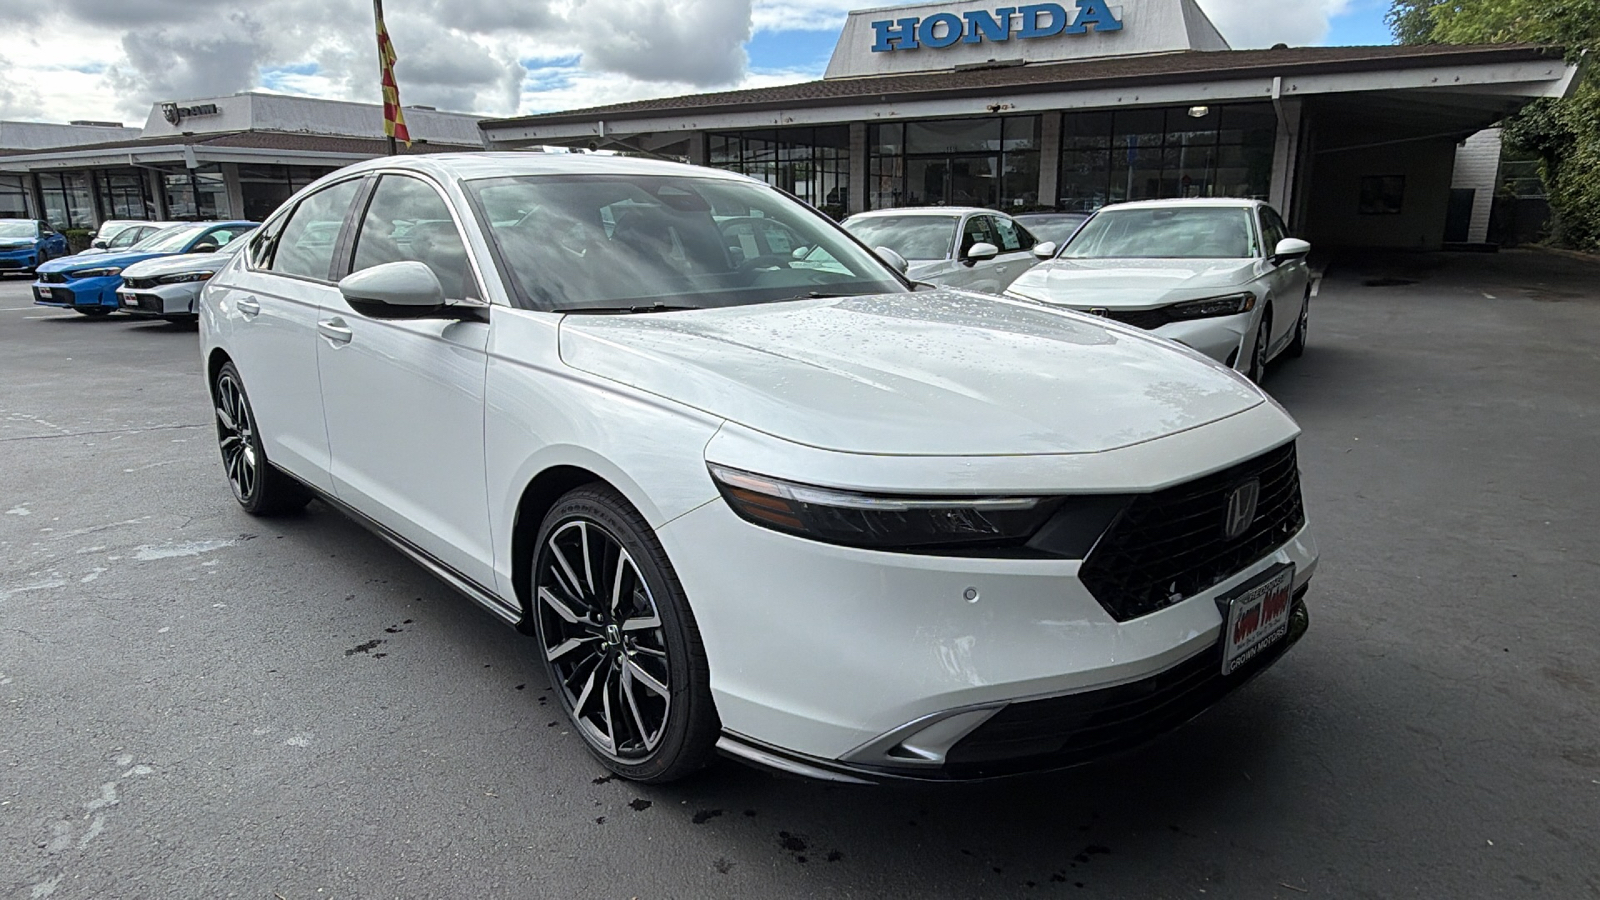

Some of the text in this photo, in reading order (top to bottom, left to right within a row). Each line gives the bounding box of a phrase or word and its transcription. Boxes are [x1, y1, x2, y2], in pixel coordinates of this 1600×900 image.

[871, 0, 1123, 52] HONDA
[178, 104, 217, 117] RAM
[1230, 646, 1257, 670] CROWN
[1257, 626, 1285, 653] MOTORS
